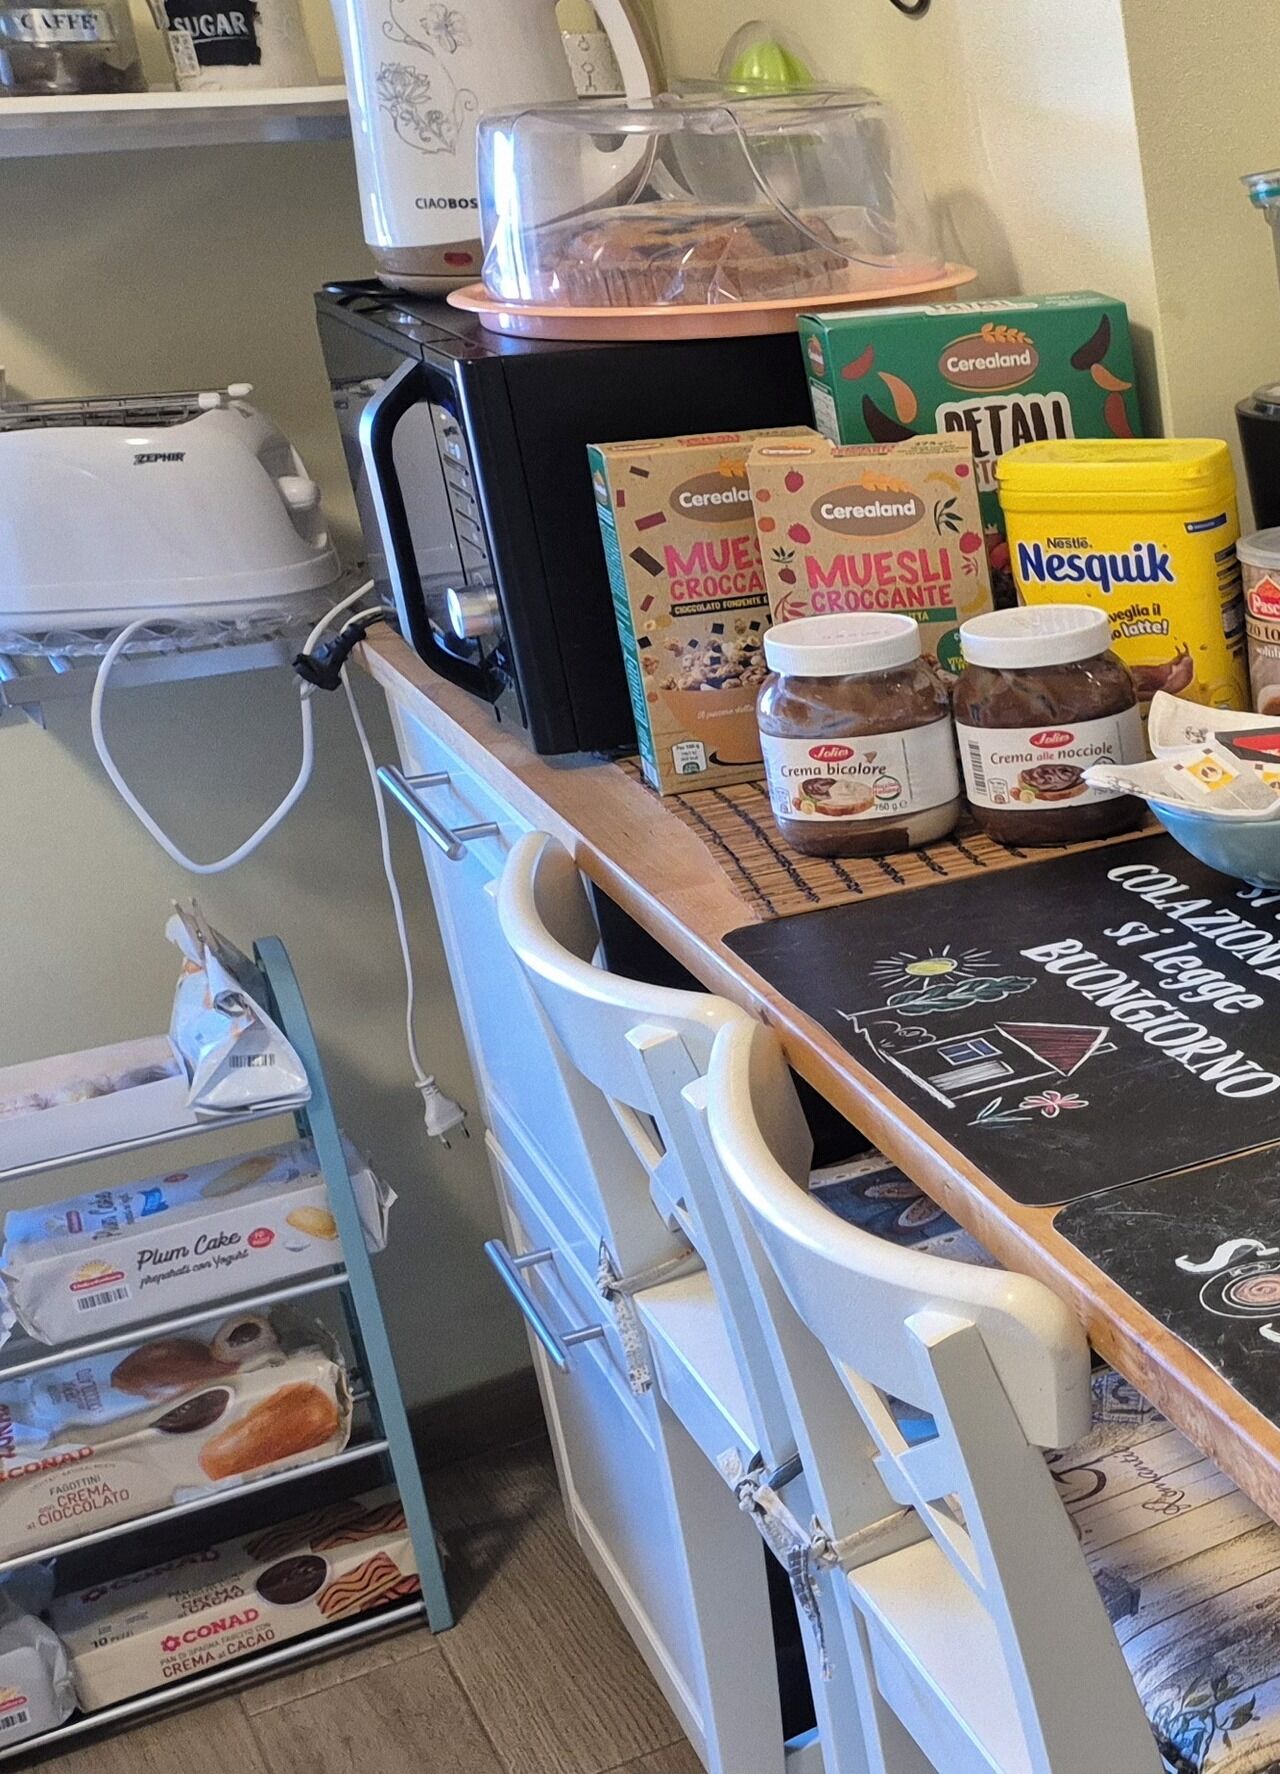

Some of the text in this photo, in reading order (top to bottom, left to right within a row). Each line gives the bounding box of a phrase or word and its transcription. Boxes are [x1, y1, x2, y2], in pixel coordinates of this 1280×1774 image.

[174, 12, 248, 37] SUGAR
[415, 197, 479, 210] CIAOBOS
[946, 350, 1031, 373] Cerealand
[133, 451, 185, 466] ZEPHIR
[679, 487, 753, 508] Cereala
[820, 499, 916, 520] Cerealand
[664, 535, 762, 578] MUE
[804, 548, 953, 590] MUESLI
[1017, 543, 1175, 593] Nesquik
[670, 571, 766, 601] CROCCA
[811, 584, 954, 613] CROCCANTE
[674, 602, 721, 615] CIOCCOLATO
[722, 598, 761, 610] FONDENTE
[1152, 603, 1162, 616] il
[1121, 619, 1169, 638] latte!
[991, 742, 1113, 765] Crema alle nocciole
[781, 762, 887, 778] Crema bicolore
[1104, 918, 1265, 1016] si legge
[137, 1249, 190, 1271] Plum
[194, 1231, 242, 1256] Cake
[140, 1265, 191, 1289] preparati
[213, 1249, 249, 1269] Yogurt
[9, 1447, 95, 1479] CONAD
[49, 1474, 101, 1496] FAGOTTINI
[57, 1482, 112, 1508] CREMA
[38, 1489, 130, 1527] CIOCCOLATO
[182, 1608, 260, 1644] CONAD
[162, 1650, 216, 1678] CREMA
[227, 1629, 276, 1656] CACAO
